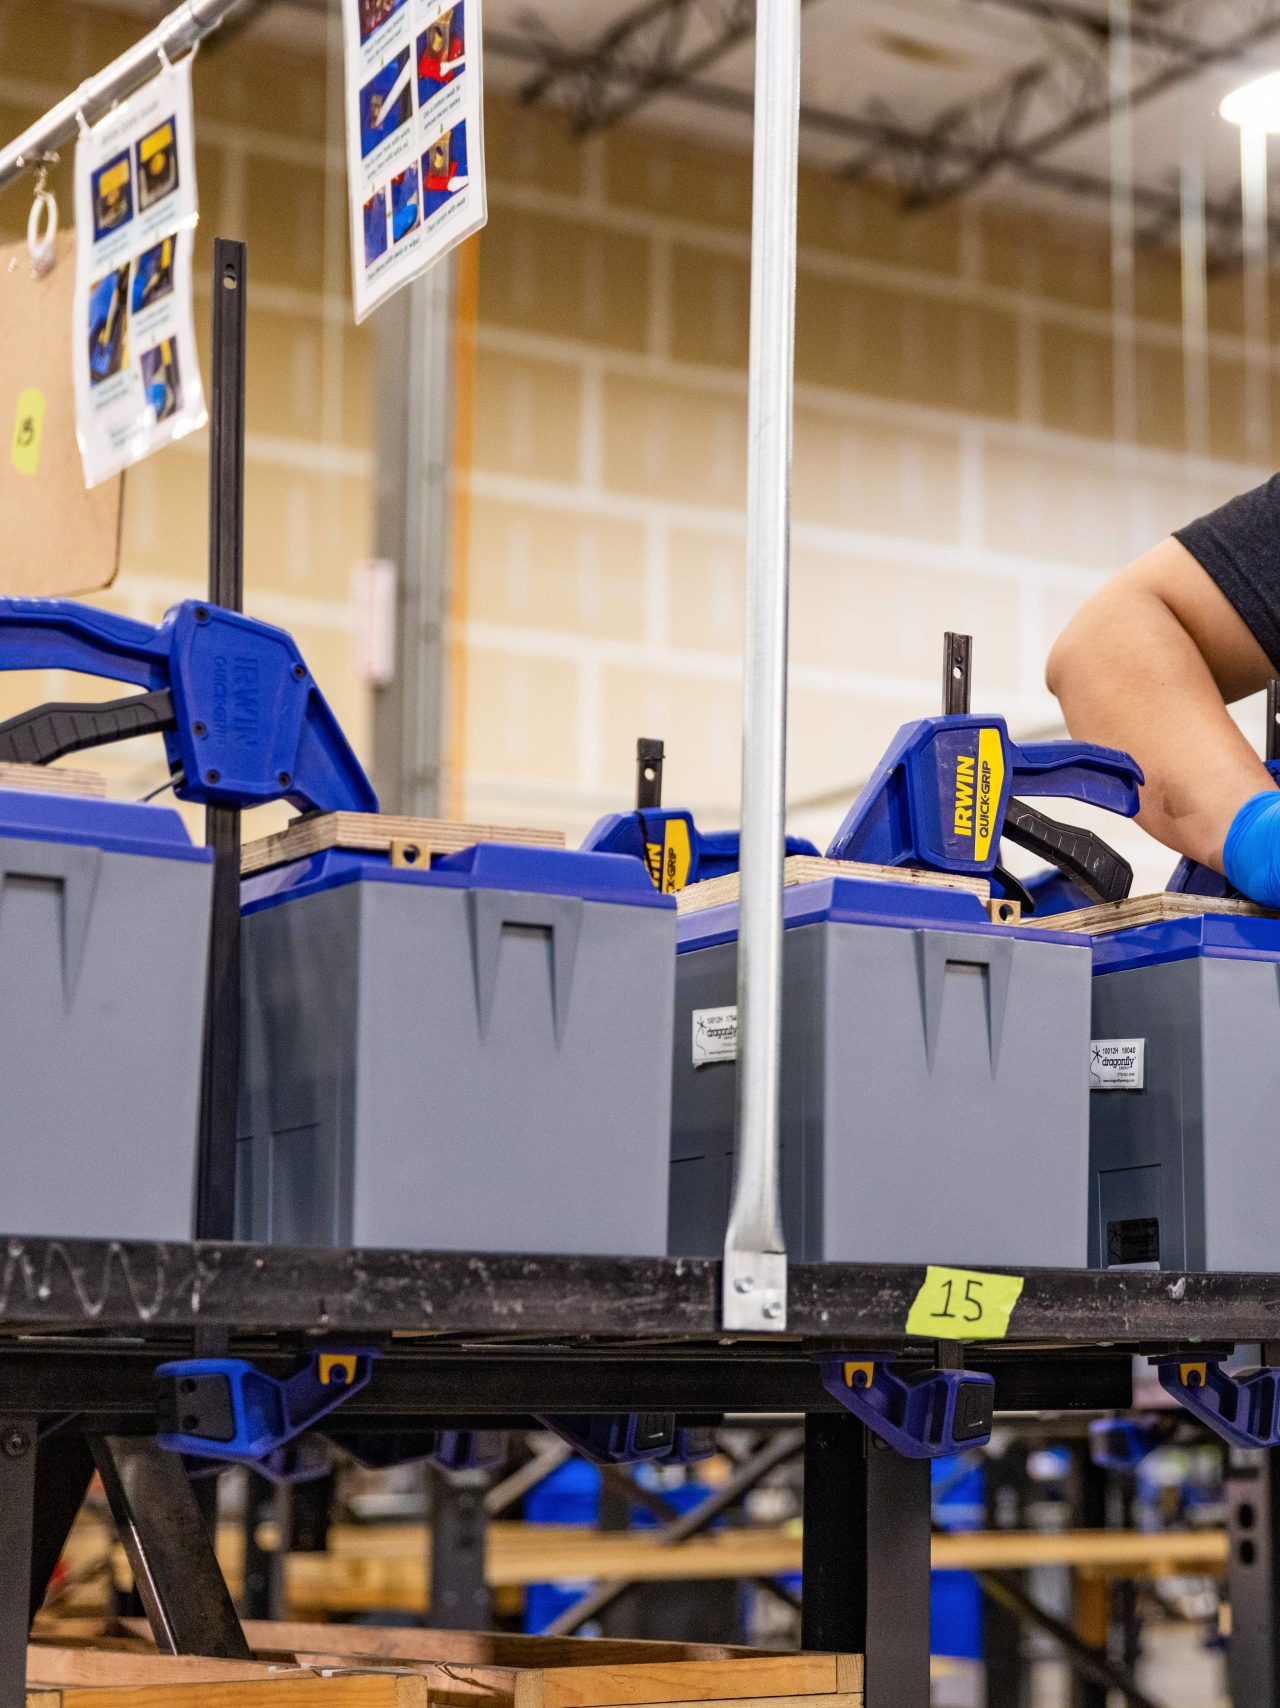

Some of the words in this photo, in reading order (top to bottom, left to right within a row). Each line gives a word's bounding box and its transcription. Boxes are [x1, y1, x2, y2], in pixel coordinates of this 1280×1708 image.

[954, 755, 975, 836] IRWIN
[980, 760, 991, 838] QUICK-GRIP
[1101, 1056, 1135, 1069] dragonfly
[930, 1279, 983, 1322] 15
